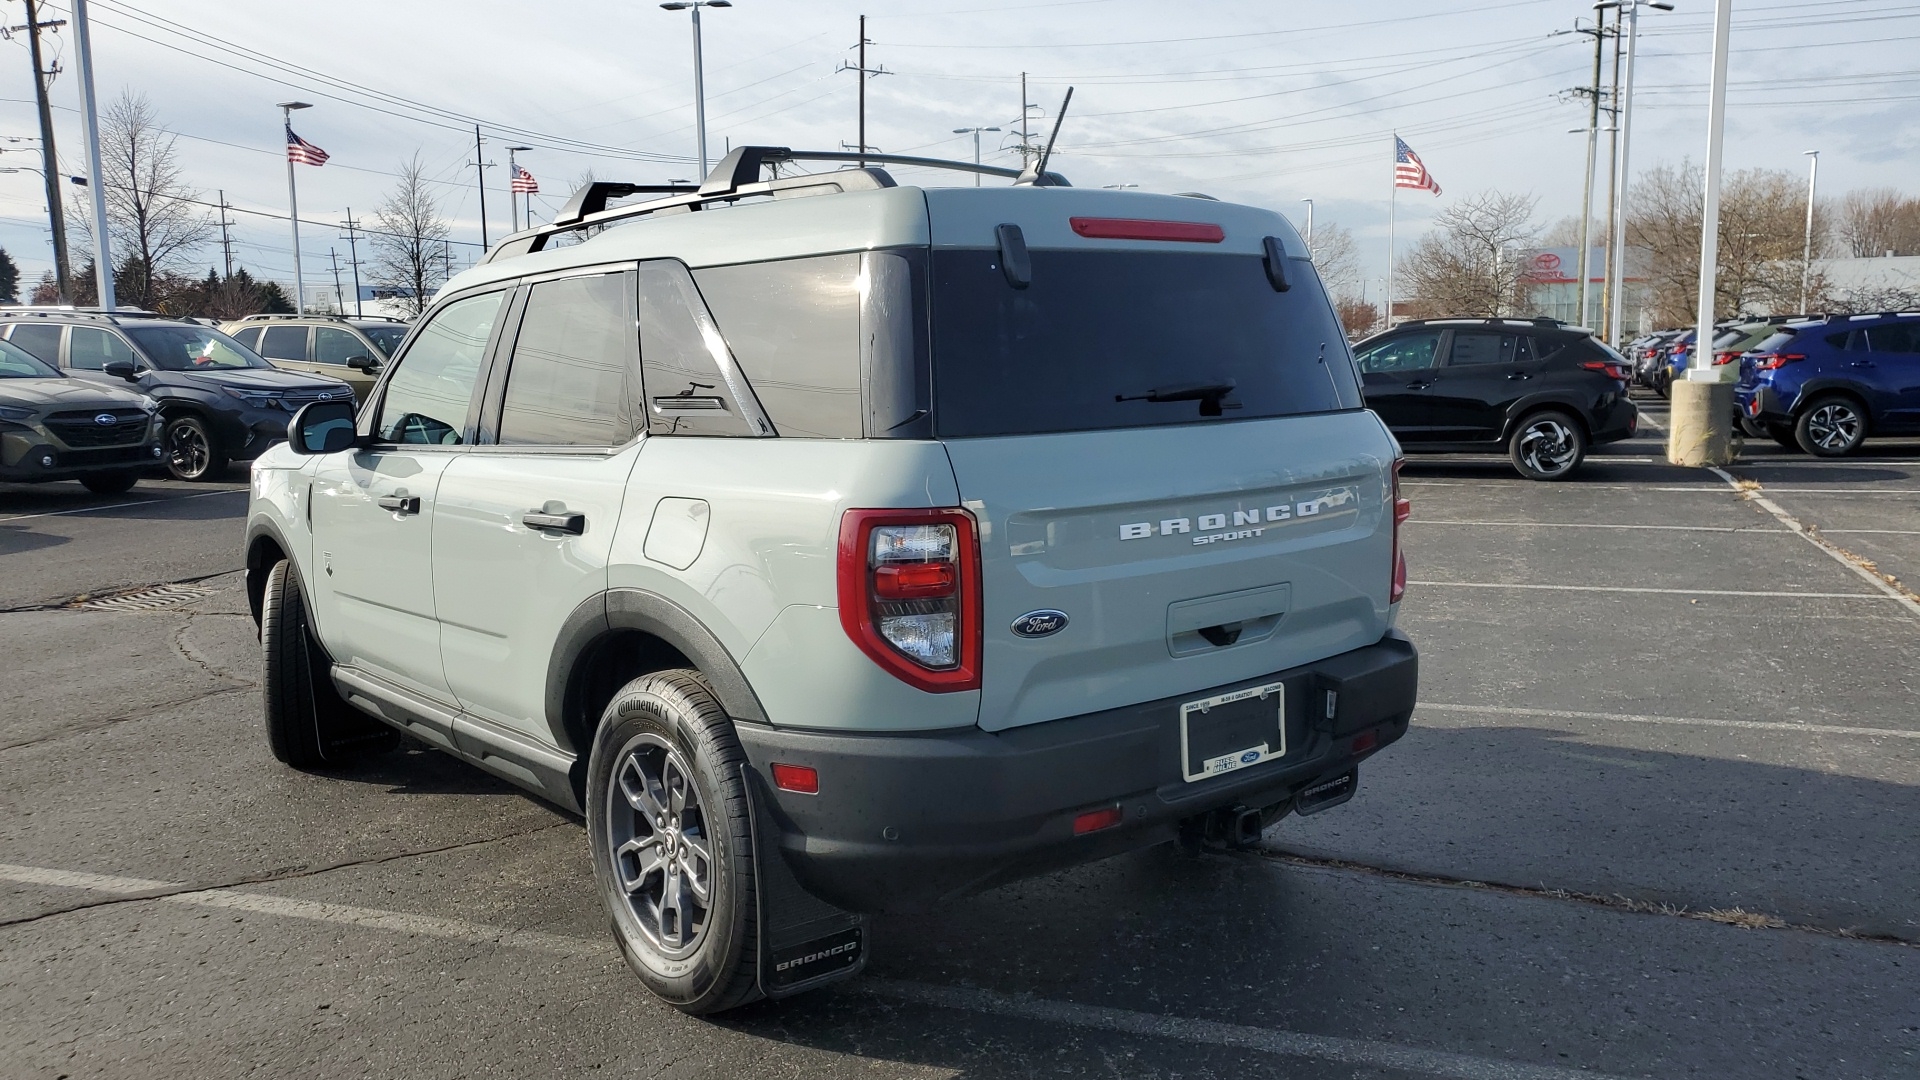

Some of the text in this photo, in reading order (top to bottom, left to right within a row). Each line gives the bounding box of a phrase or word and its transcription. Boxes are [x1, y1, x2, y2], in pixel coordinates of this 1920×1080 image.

[1119, 501, 1320, 541] BRONCO
[1192, 528, 1266, 546] SPORT
[1025, 615, 1058, 634] Ford
[618, 696, 663, 717] Continental
[1186, 702, 1200, 711] SINCE
[1215, 756, 1235, 766] RUSS
[1242, 752, 1258, 762] Ford
[1213, 761, 1237, 773] MILNE
[1304, 775, 1350, 796] BRONCO
[776, 941, 857, 972] BRONCO
